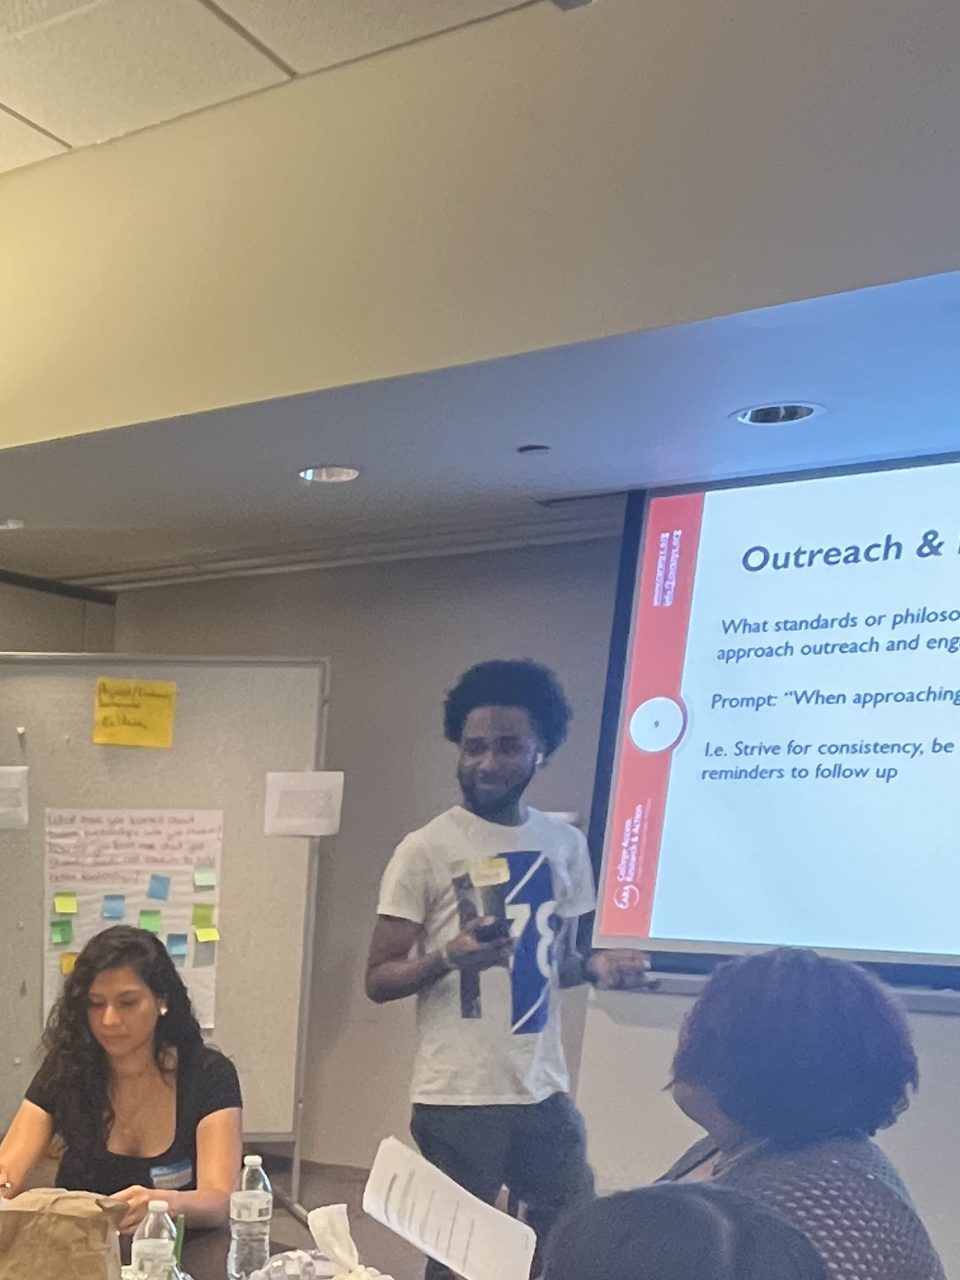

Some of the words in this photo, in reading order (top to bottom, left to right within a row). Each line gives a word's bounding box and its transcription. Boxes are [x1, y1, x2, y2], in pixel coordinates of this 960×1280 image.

[742, 534, 903, 572] Outreach
[916, 529, 945, 558] &
[721, 618, 769, 635] What
[774, 612, 858, 633] standards
[865, 614, 887, 627] or
[716, 640, 794, 664] approach
[801, 636, 880, 656] outreach
[886, 634, 920, 652] and
[926, 636, 960, 654] eng
[711, 693, 778, 712] Prompt:
[734, 740, 782, 757] Strive
[787, 739, 813, 756] for
[817, 739, 925, 759] consistency,
[931, 737, 956, 754] be
[701, 764, 785, 780] reminders
[791, 765, 809, 779] to
[815, 763, 870, 780] follow
[875, 766, 899, 784] up
